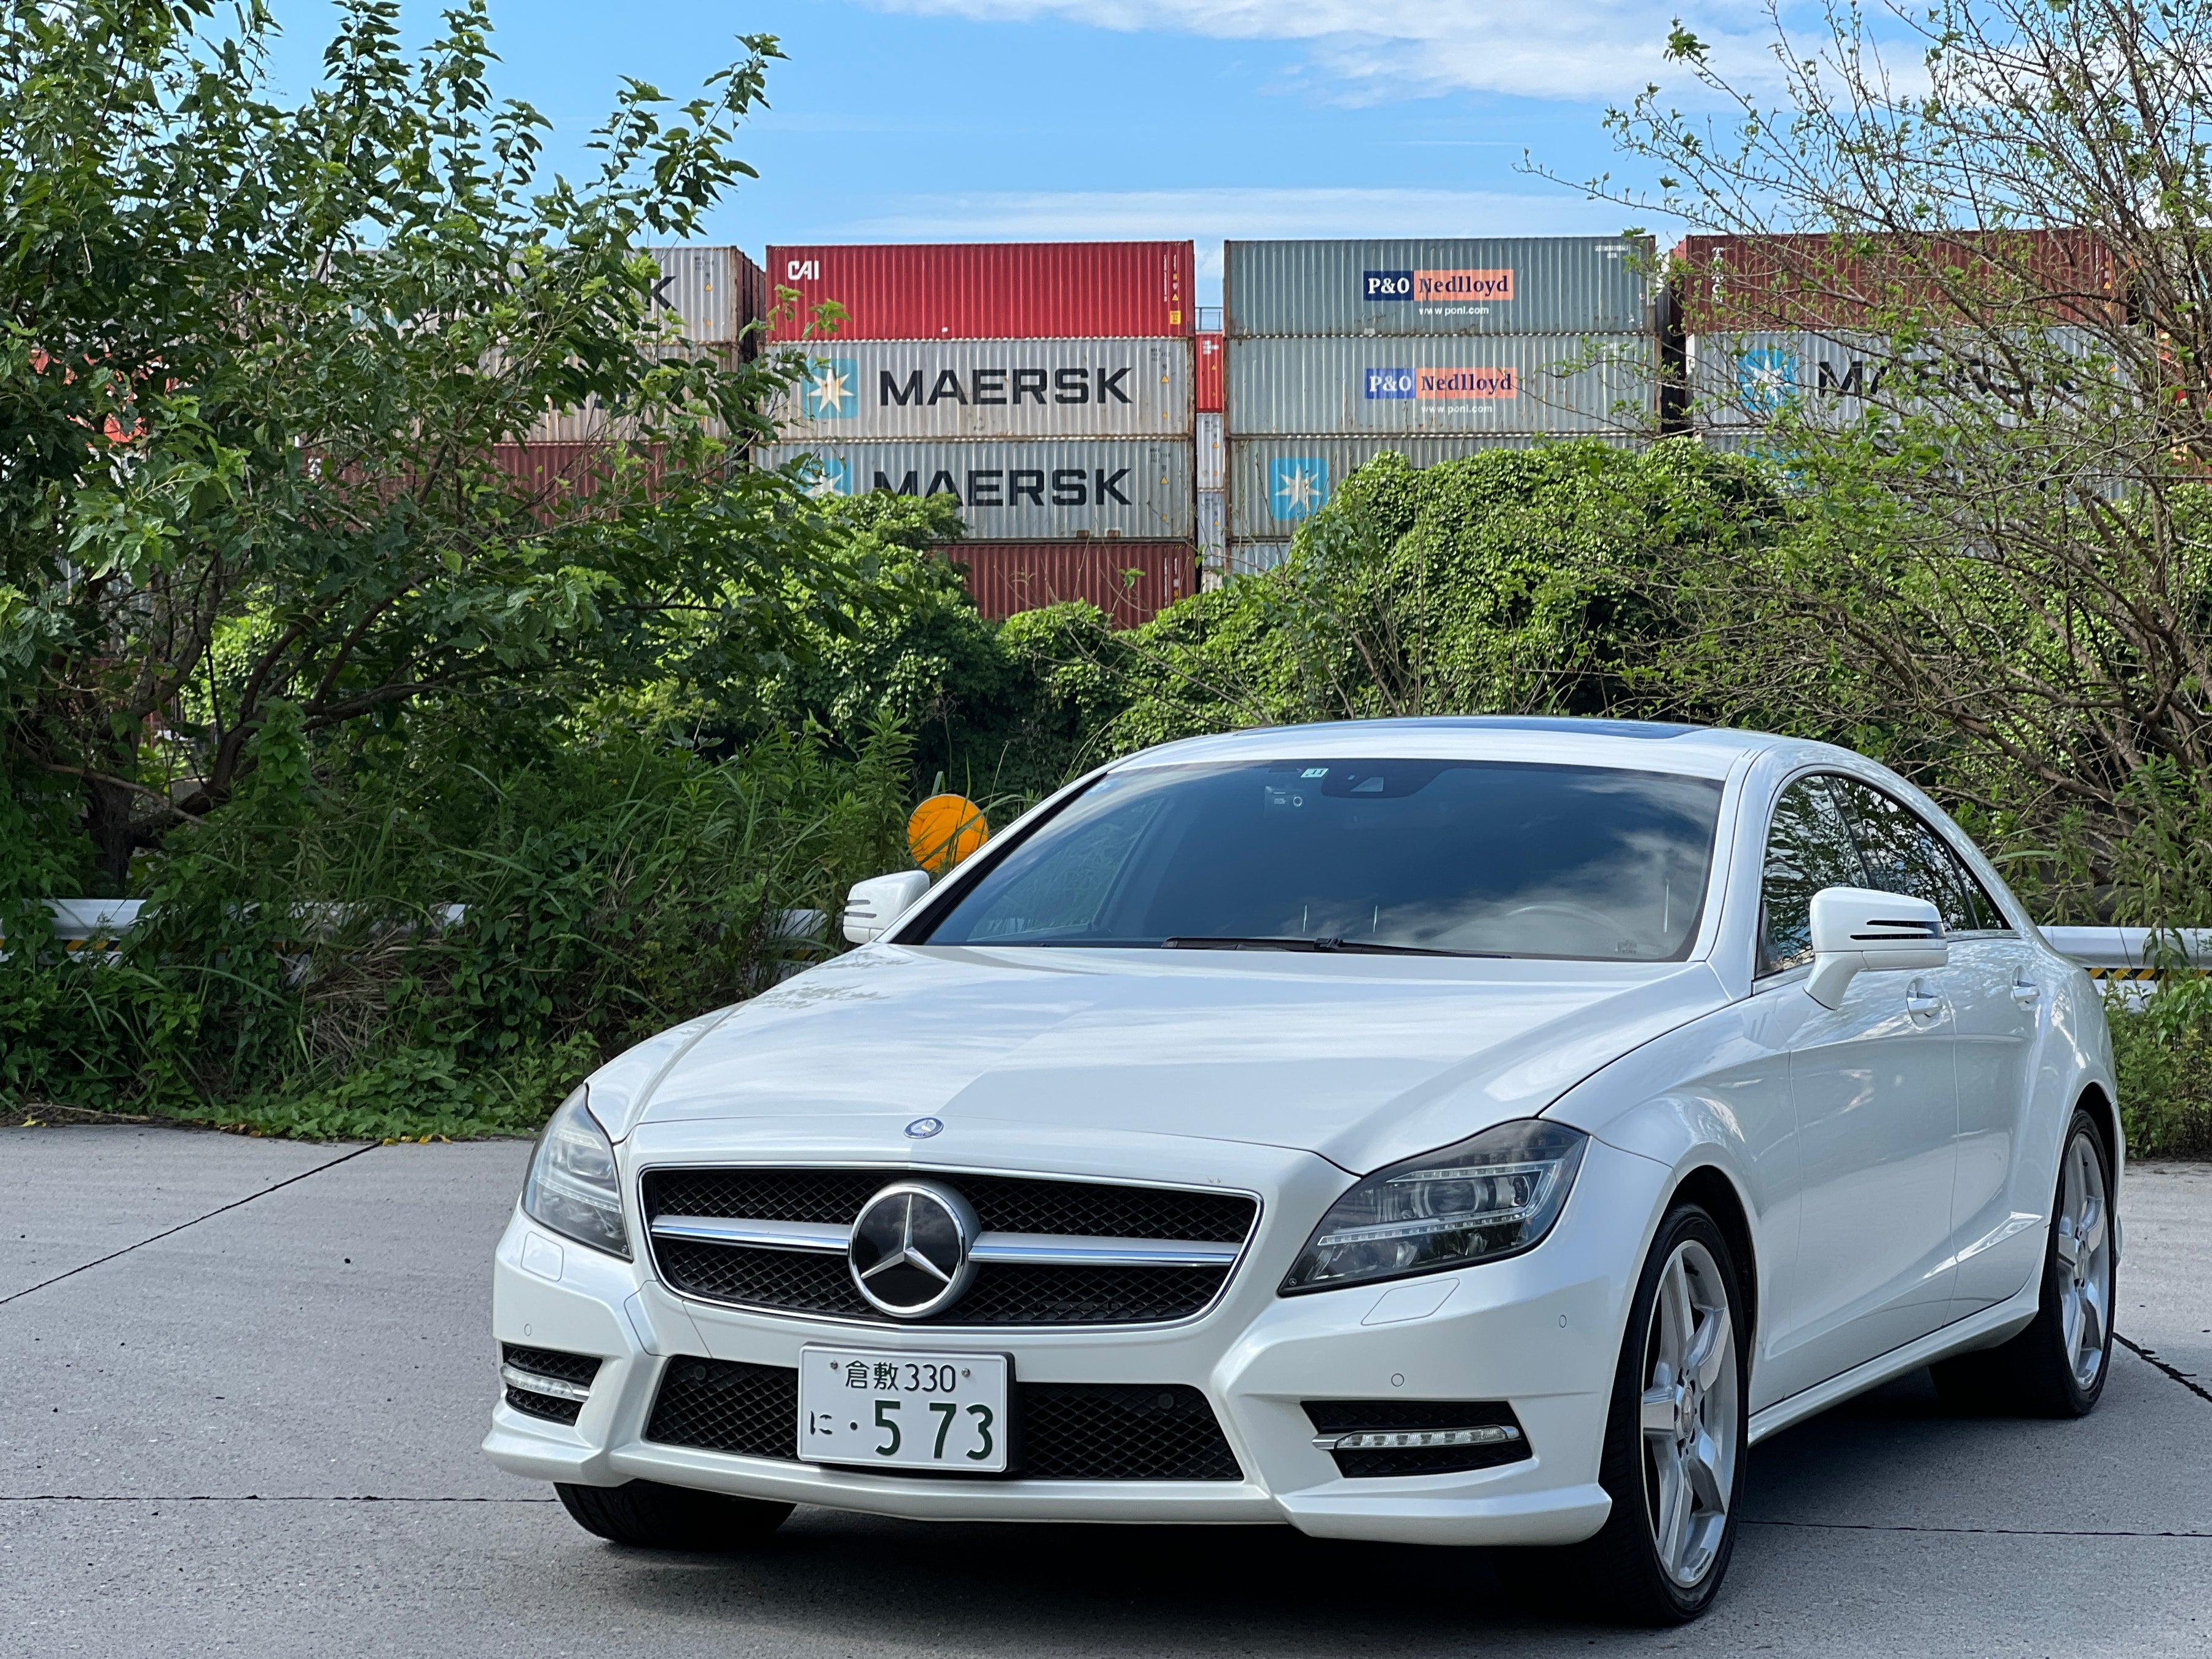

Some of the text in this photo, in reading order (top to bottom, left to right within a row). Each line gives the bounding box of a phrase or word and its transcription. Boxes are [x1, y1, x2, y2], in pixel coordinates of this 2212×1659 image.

[788, 260, 820, 281] CAI
[1367, 275, 1509, 297] P&O Nedlloyd
[1418, 305, 1489, 316] wwwponl.com
[880, 367, 1133, 406] MAERSK
[1368, 374, 1512, 395] P&O Nedlloyd
[874, 468, 1132, 506] MAERSK
